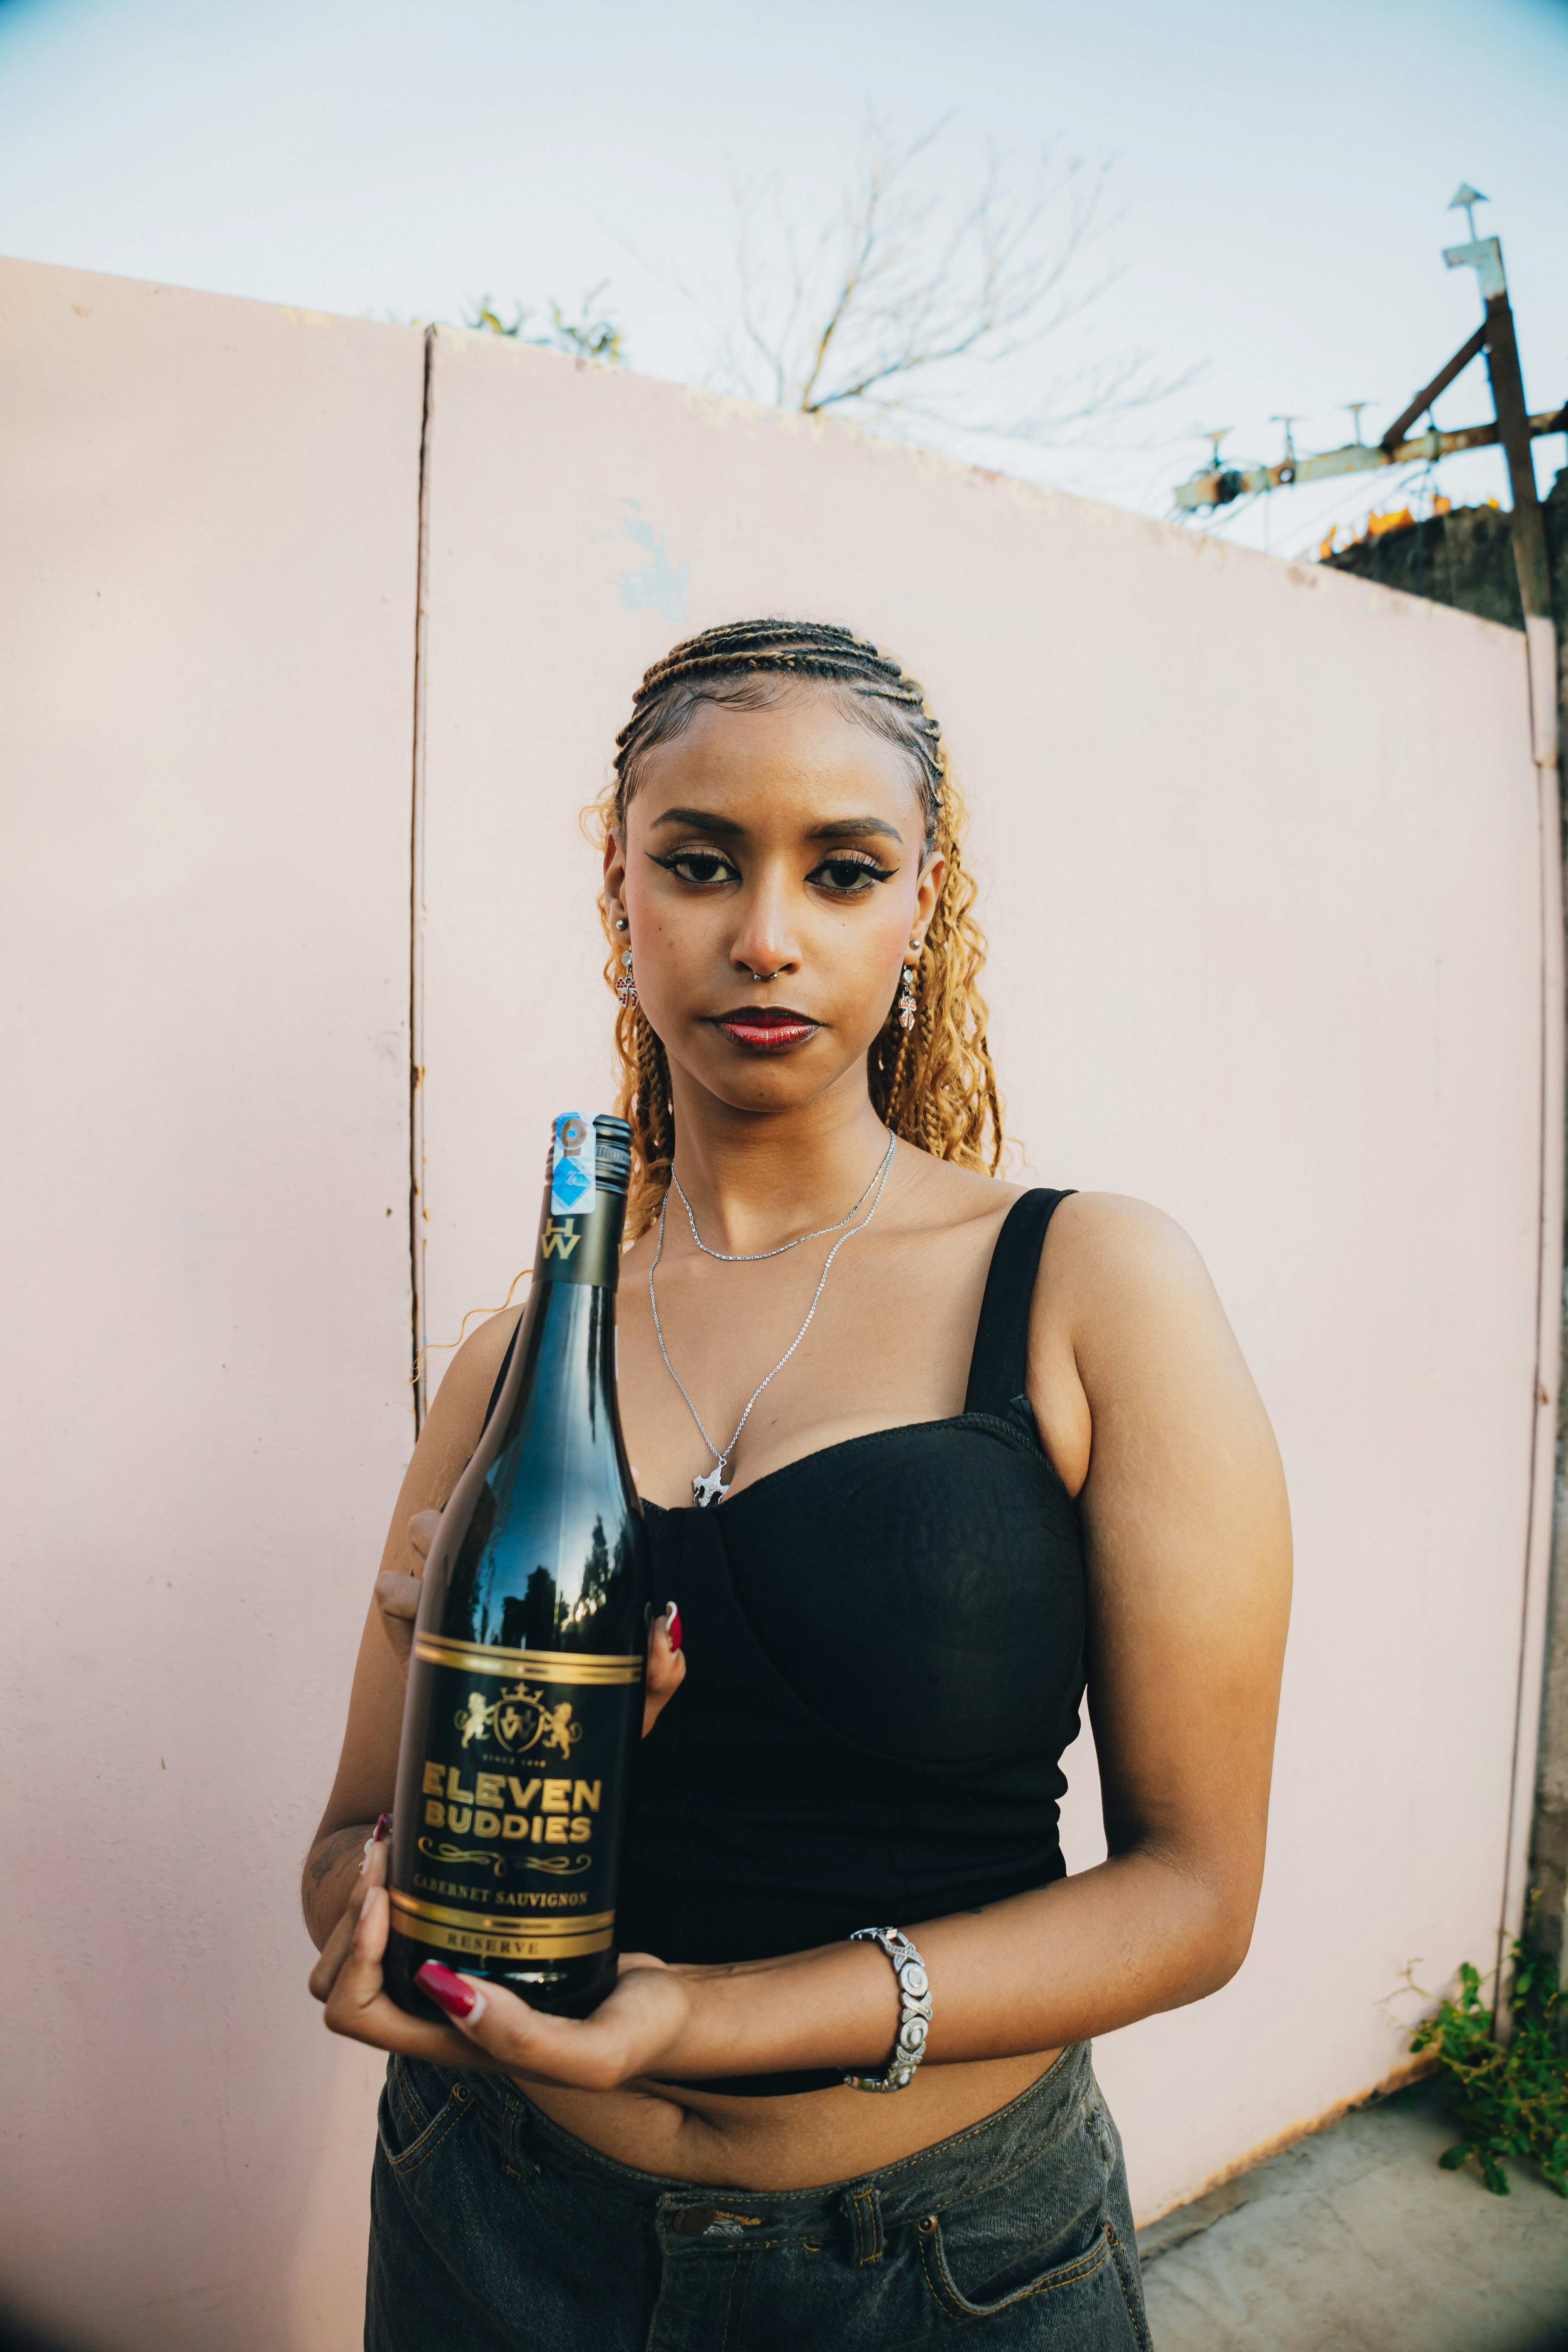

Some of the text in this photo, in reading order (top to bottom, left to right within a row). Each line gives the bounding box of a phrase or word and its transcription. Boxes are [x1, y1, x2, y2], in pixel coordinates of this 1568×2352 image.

[422, 1761, 602, 1813] ELEVEN
[424, 1799, 592, 1844] BUDDIES
[414, 1873, 588, 1908] CABERNET SAUVIGNON
[447, 1932, 539, 1955] RESERVE
